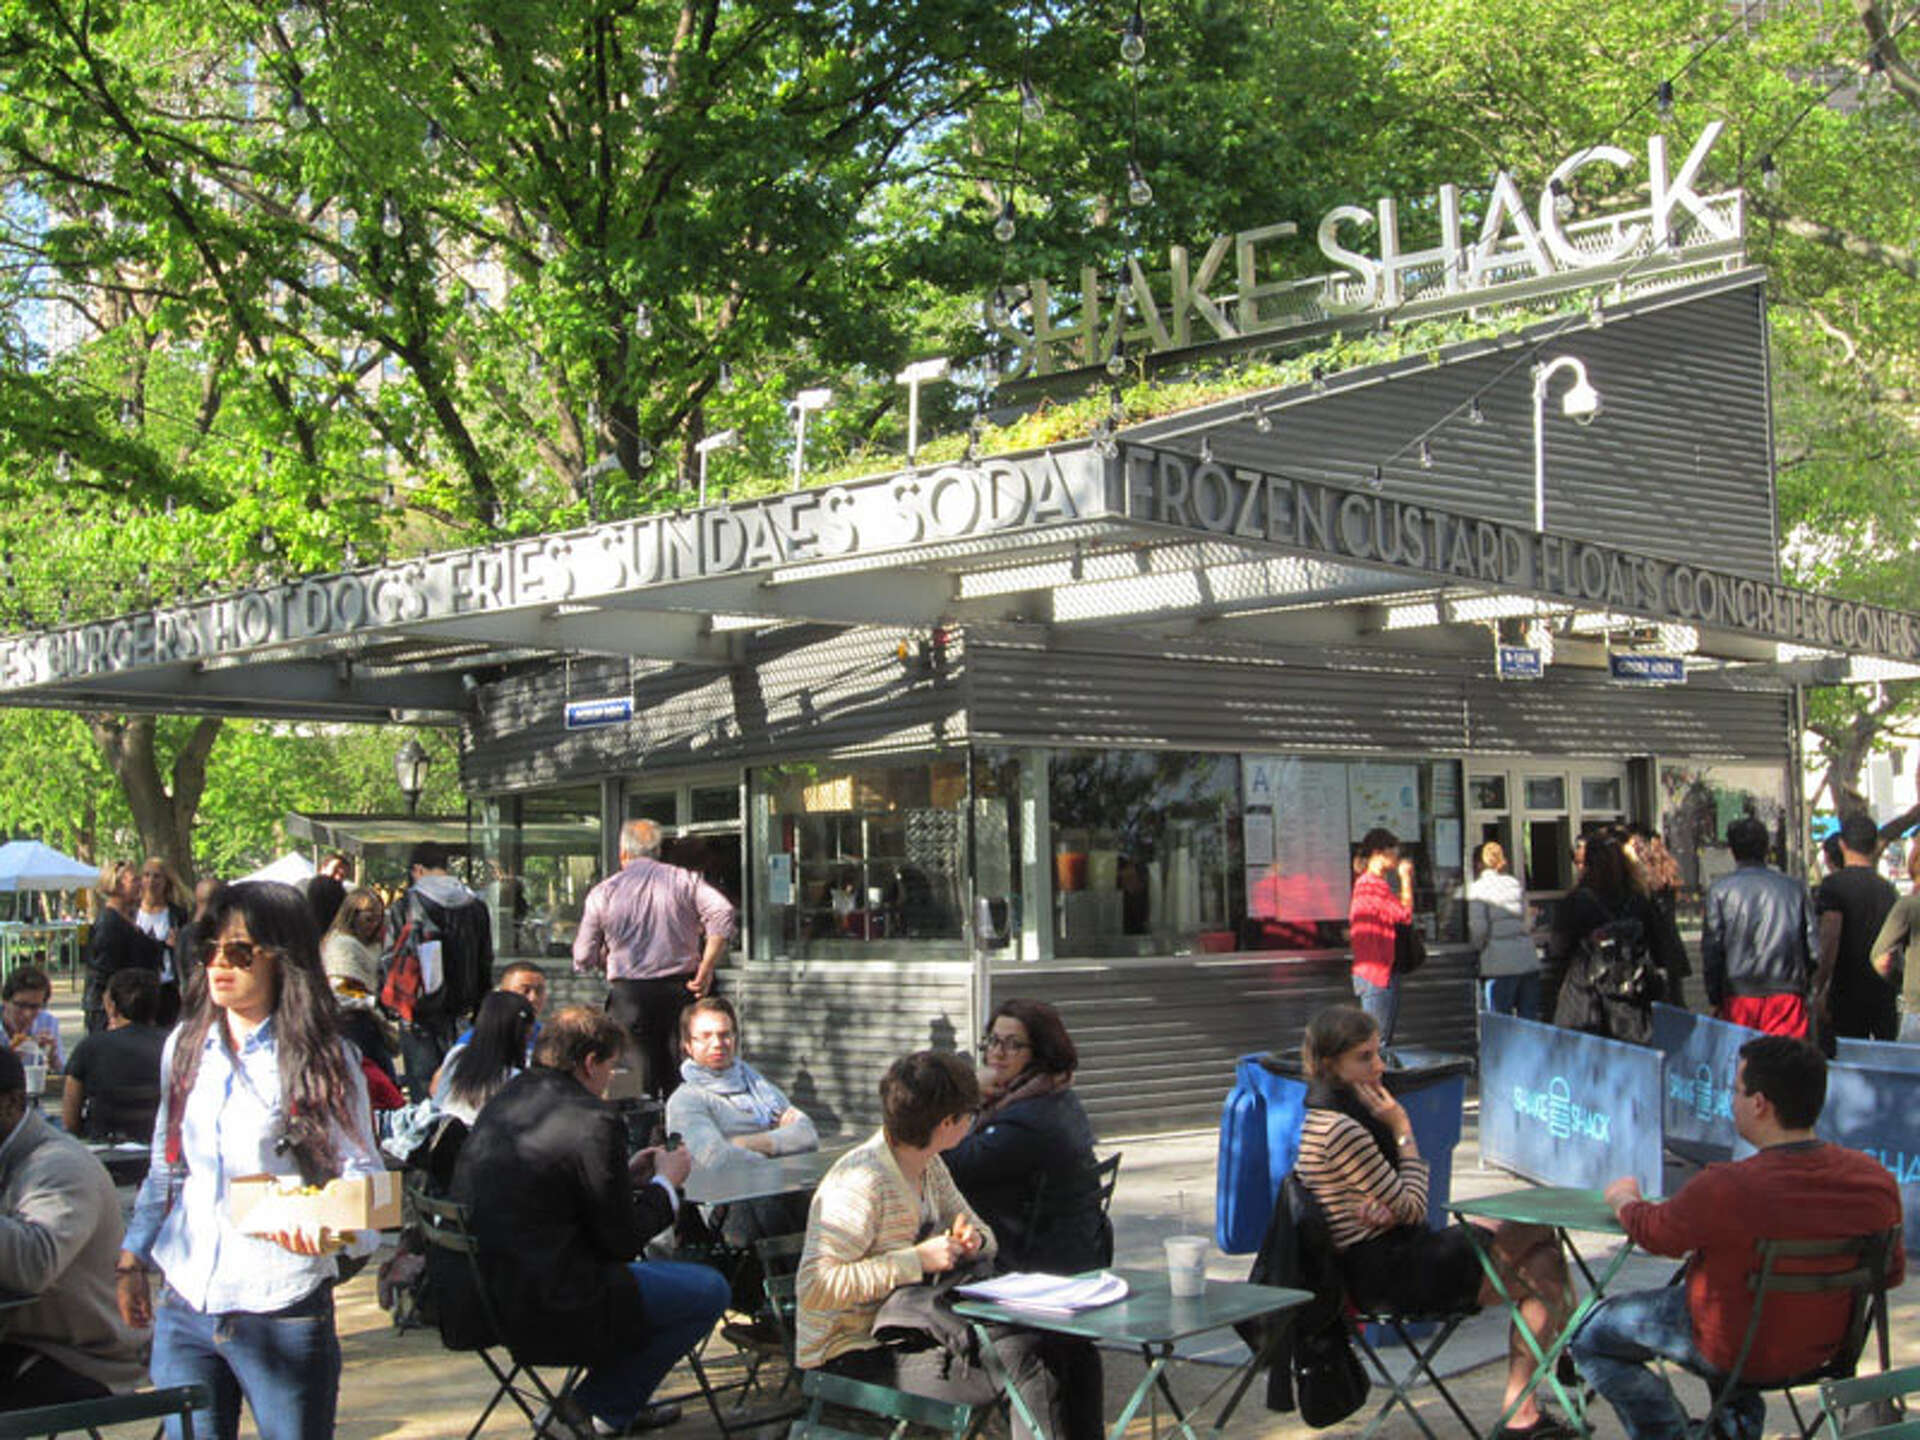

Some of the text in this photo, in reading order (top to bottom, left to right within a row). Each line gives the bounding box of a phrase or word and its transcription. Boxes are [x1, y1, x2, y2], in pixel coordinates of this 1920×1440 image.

[1317, 119, 1725, 313] SHACK
[43, 609, 200, 677] BURGERS
[212, 586, 293, 650] HOT
[303, 565, 427, 636] DOGS
[451, 537, 574, 612] FRIES
[597, 486, 858, 590] SUNDAES
[889, 450, 1077, 543] SODA
[1126, 446, 1332, 552] FROZEN
[1340, 494, 1529, 582] CUSTARD
[1541, 536, 1662, 613] FLOATS
[1674, 566, 1830, 642] CONCRETES
[1513, 1086, 1611, 1143] SHAKE SHACK
